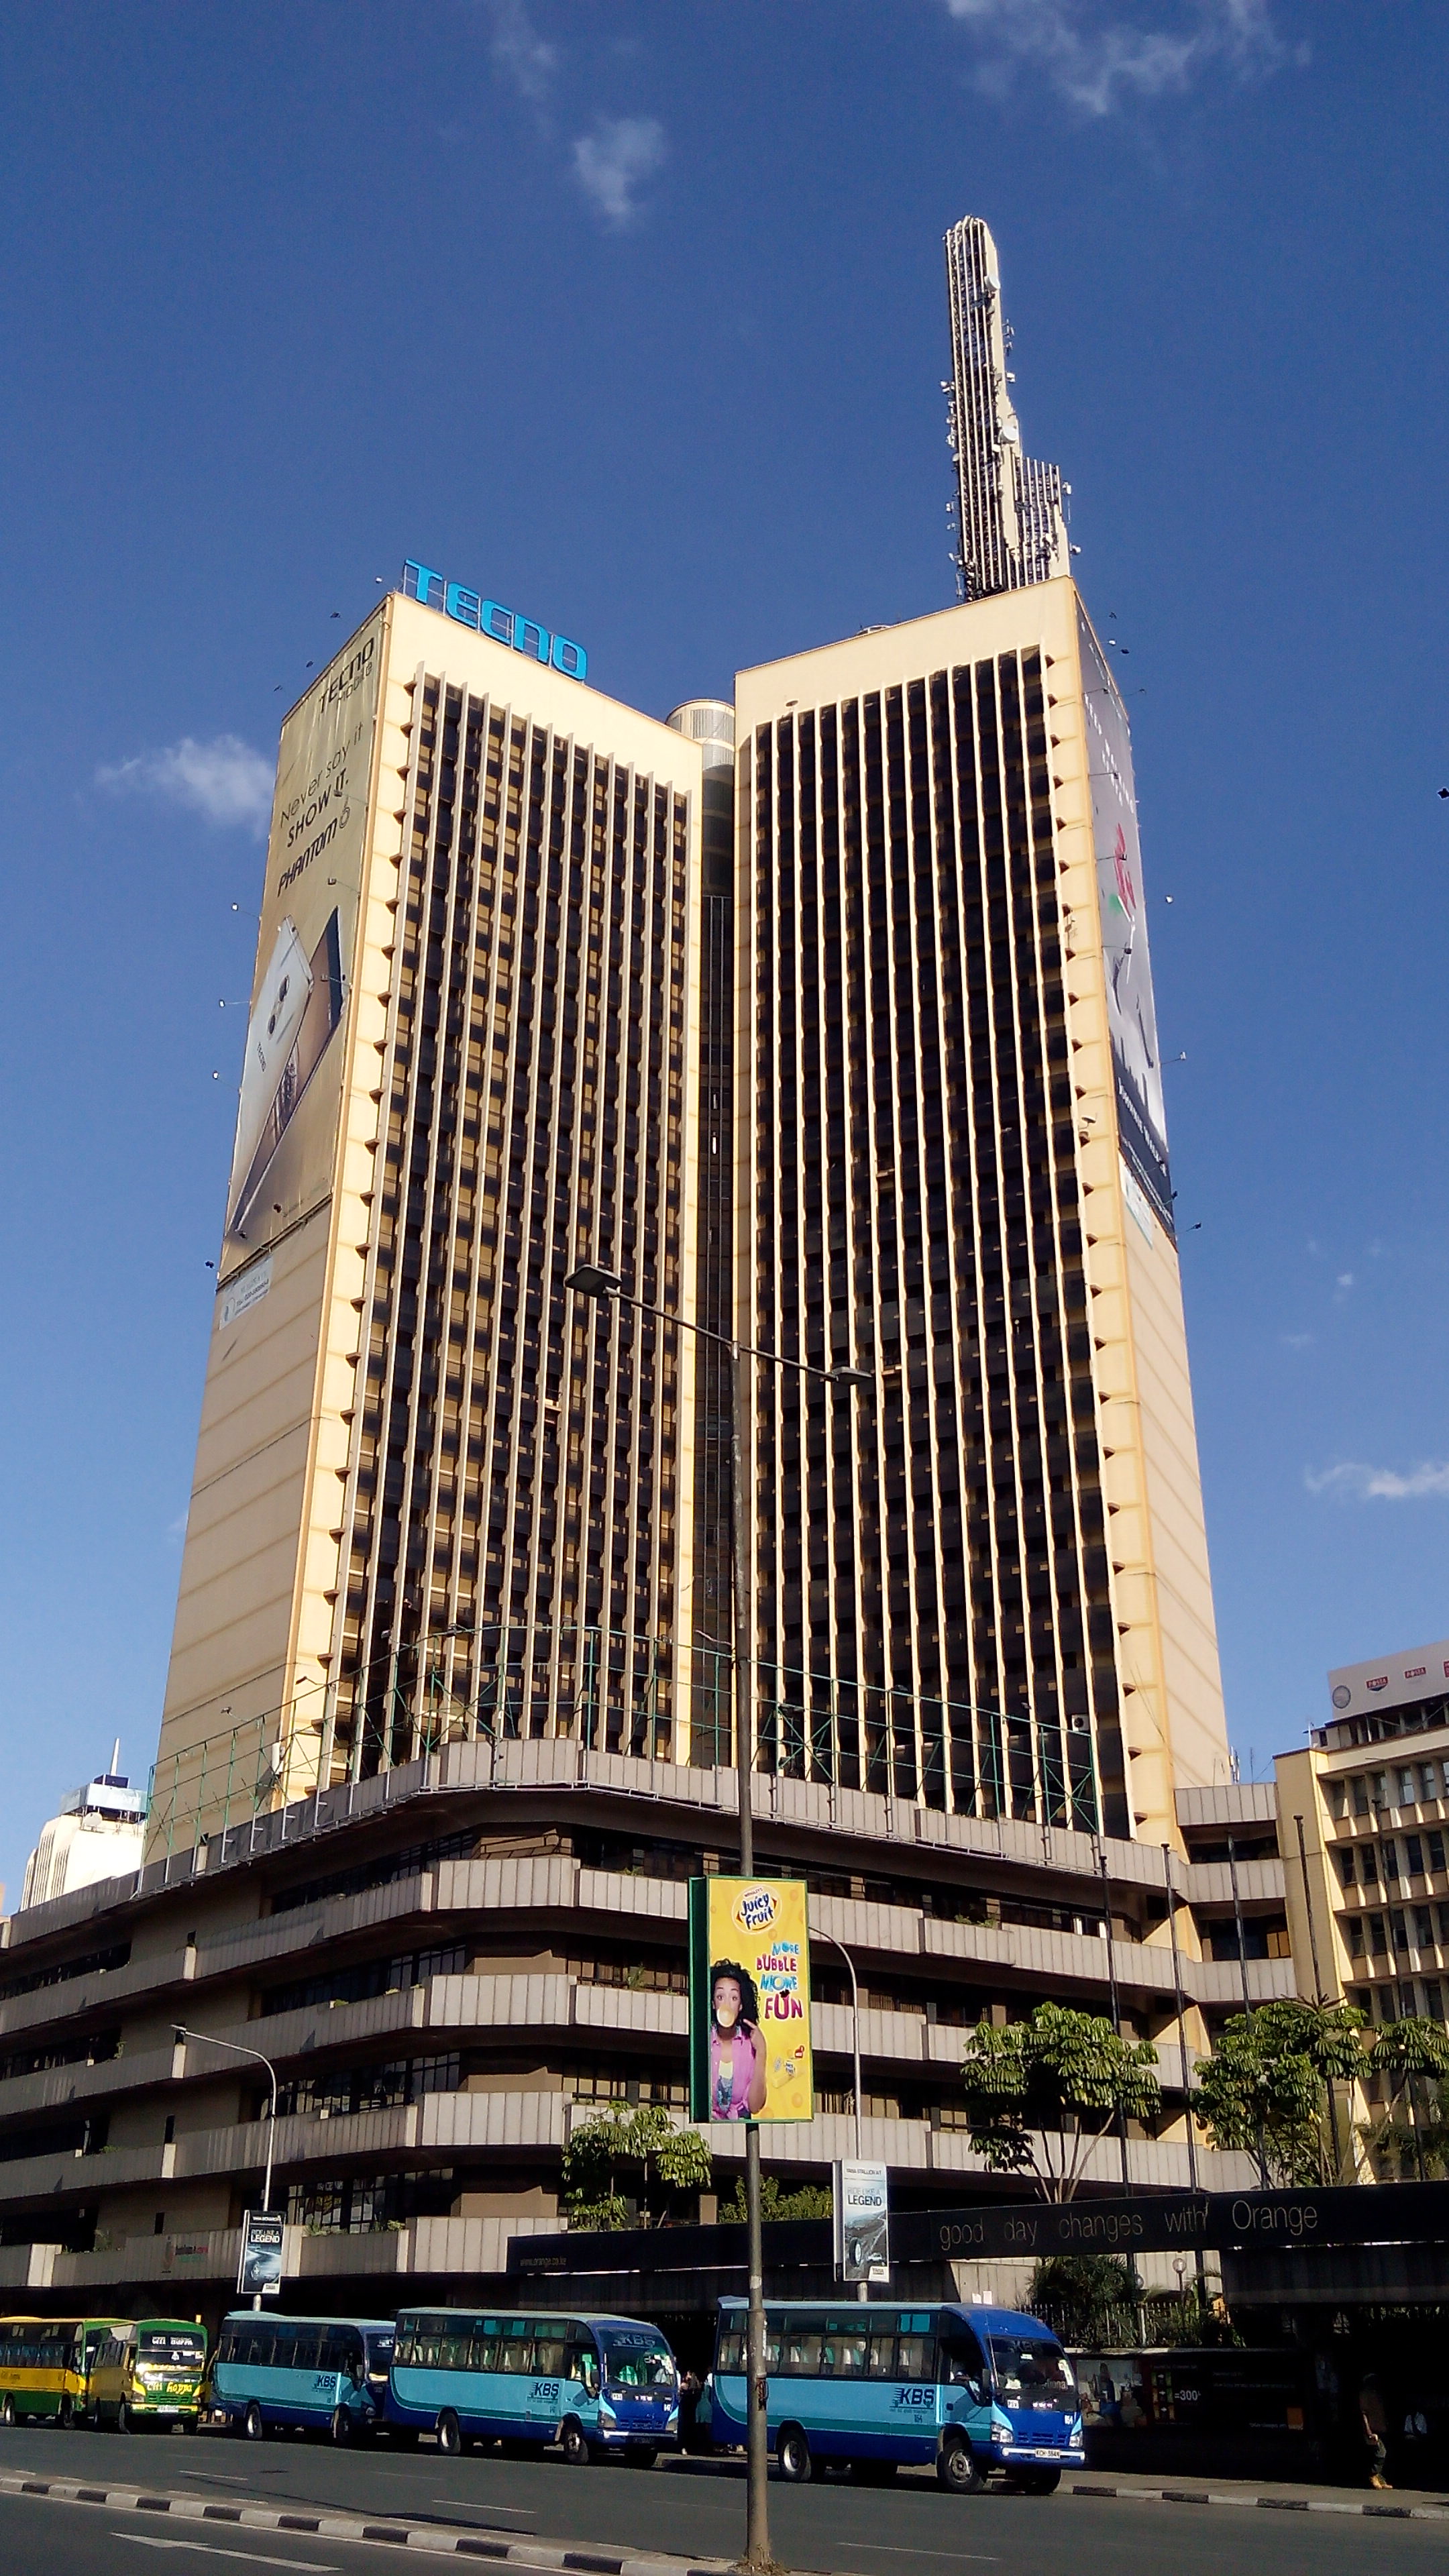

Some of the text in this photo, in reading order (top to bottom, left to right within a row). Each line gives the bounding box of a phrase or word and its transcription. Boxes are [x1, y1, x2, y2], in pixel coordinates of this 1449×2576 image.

[405, 558, 587, 680] TECNO
[319, 637, 374, 713] TECNO
[280, 770, 323, 828] Never
[287, 784, 331, 848] SHOW
[278, 818, 337, 898] PHANTOM
[741, 1893, 769, 1916] Juicy
[772, 1942, 799, 1955] MORE
[757, 1953, 797, 1972] BUBBLE
[760, 1974, 798, 1992] MORE
[765, 1993, 803, 2019] FUN
[848, 2195, 881, 2206] LEGEND
[940, 2200, 1318, 2251] good day changes with Orange
[251, 2235, 280, 2243] LEGEND
[623, 2334, 655, 2347] KBS
[317, 2375, 336, 2387] KBS
[533, 2382, 559, 2396] KBS
[896, 2387, 934, 2406] KBS
